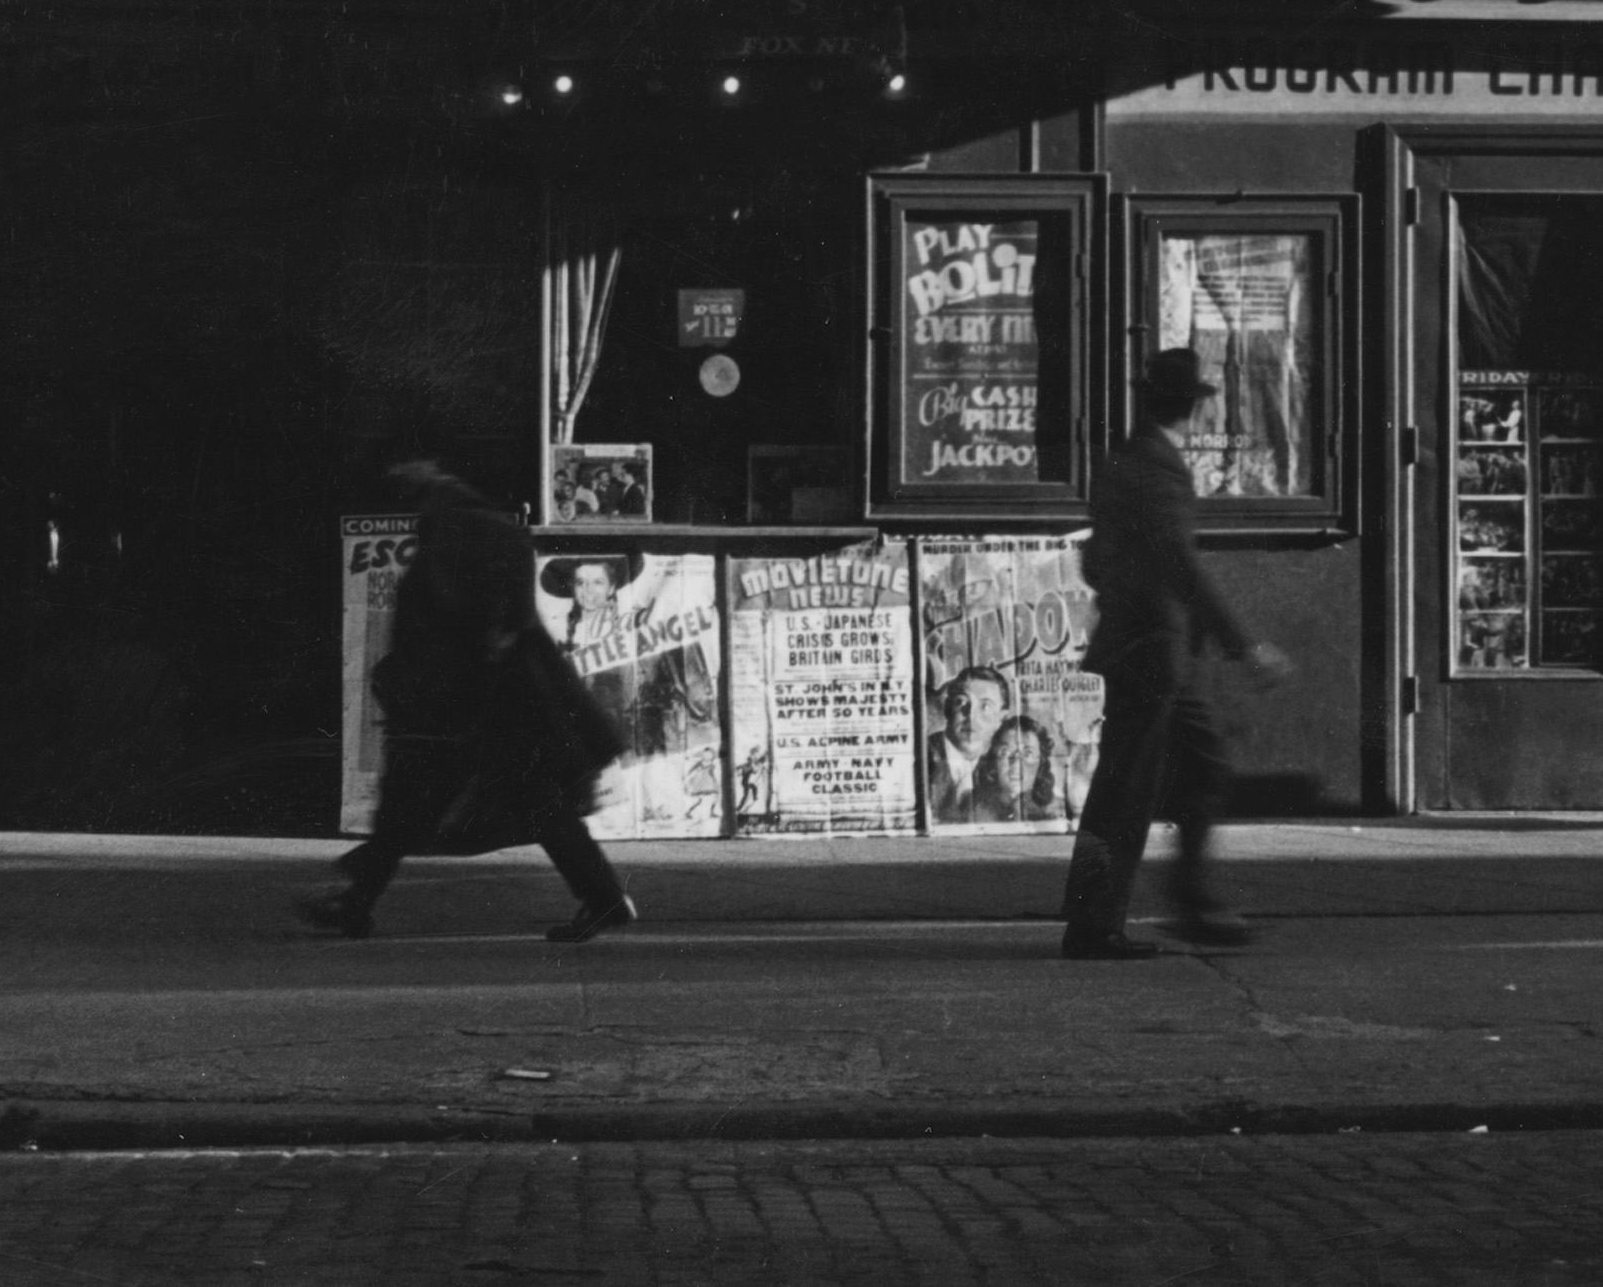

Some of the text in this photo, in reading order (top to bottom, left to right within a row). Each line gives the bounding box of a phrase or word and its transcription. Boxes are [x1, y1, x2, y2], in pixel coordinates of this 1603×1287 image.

[1163, 34, 1456, 96] PROGRAM
[914, 224, 994, 266] PLAY
[914, 315, 994, 345] EVERY
[1462, 369, 1530, 385] RIDAY
[918, 382, 1037, 427] Big CASH
[922, 440, 1037, 476] JACKPO
[349, 538, 418, 575] ESC
[740, 552, 910, 598] MOVIETONE
[788, 583, 866, 610] NEWS
[573, 604, 714, 675] TTLE ANGEL
[787, 632, 834, 649] CRISIS
[788, 647, 894, 667] BRITAIN GIRDS
[861, 680, 876, 692] IN
[774, 691, 908, 707] SHOWS MAJESTY
[777, 707, 827, 719] AFTER
[857, 704, 910, 717] YEARS
[863, 732, 908, 746] ARMY
[792, 758, 840, 771] ARMY
[851, 756, 895, 769] NAVY
[803, 768, 882, 782] FOOTBALL
[811, 781, 878, 795] CLASSIC
